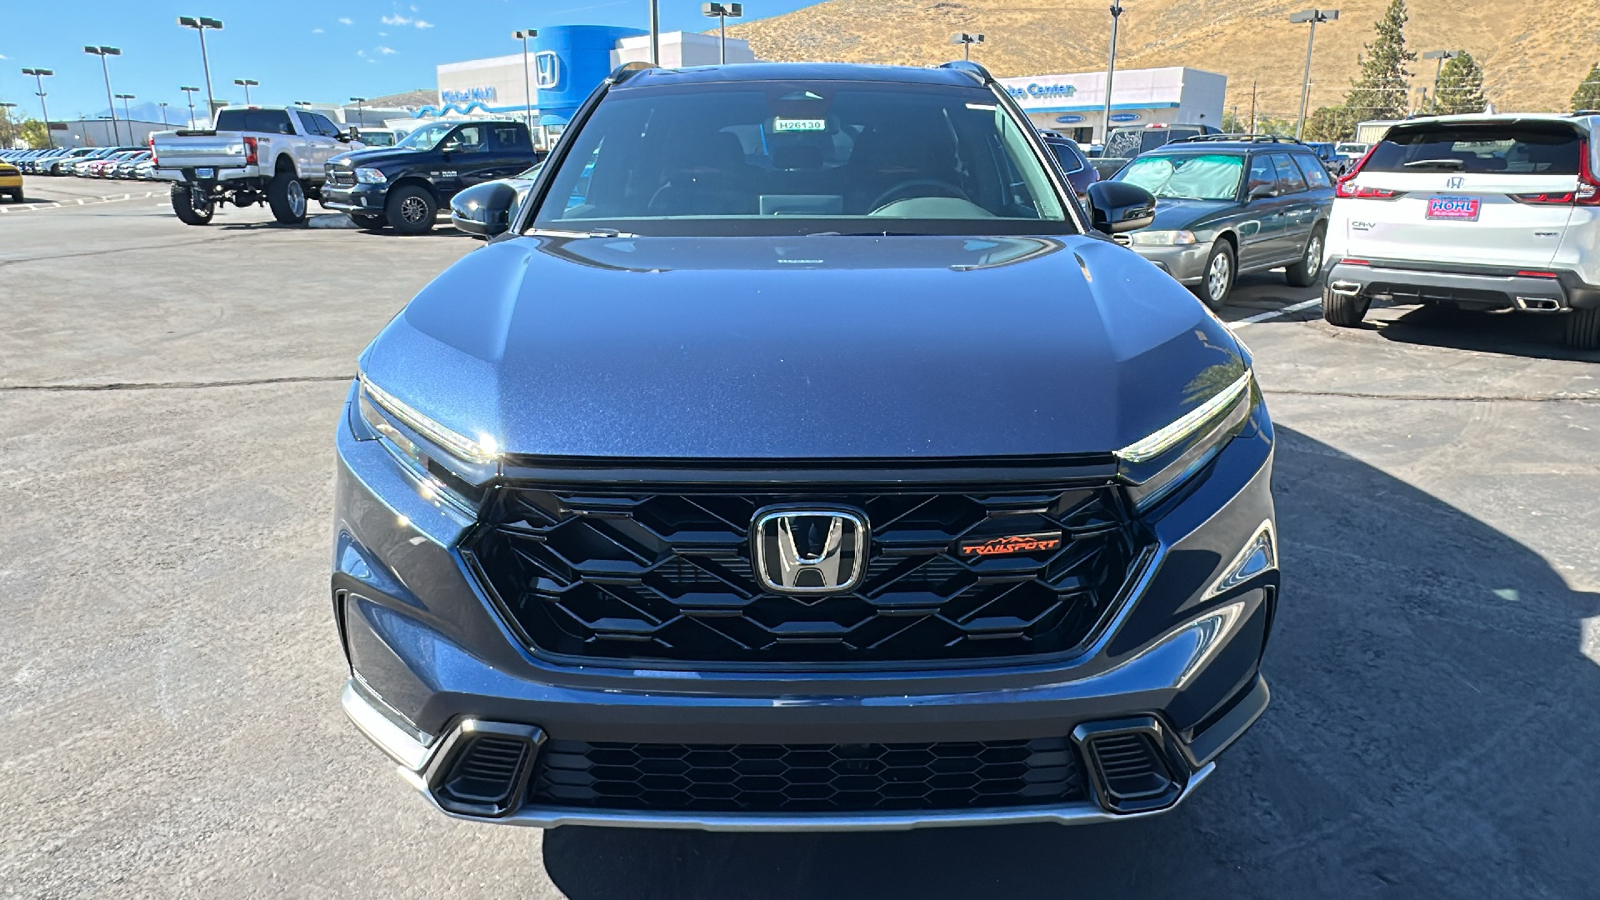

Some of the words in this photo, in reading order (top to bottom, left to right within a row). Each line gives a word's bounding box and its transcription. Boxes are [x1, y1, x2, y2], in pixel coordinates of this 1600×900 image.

[1027, 83, 1073, 95] Center
[779, 121, 821, 130] H26130
[1431, 201, 1474, 212] HOHL
[962, 540, 1059, 555] TRAILSPORT
